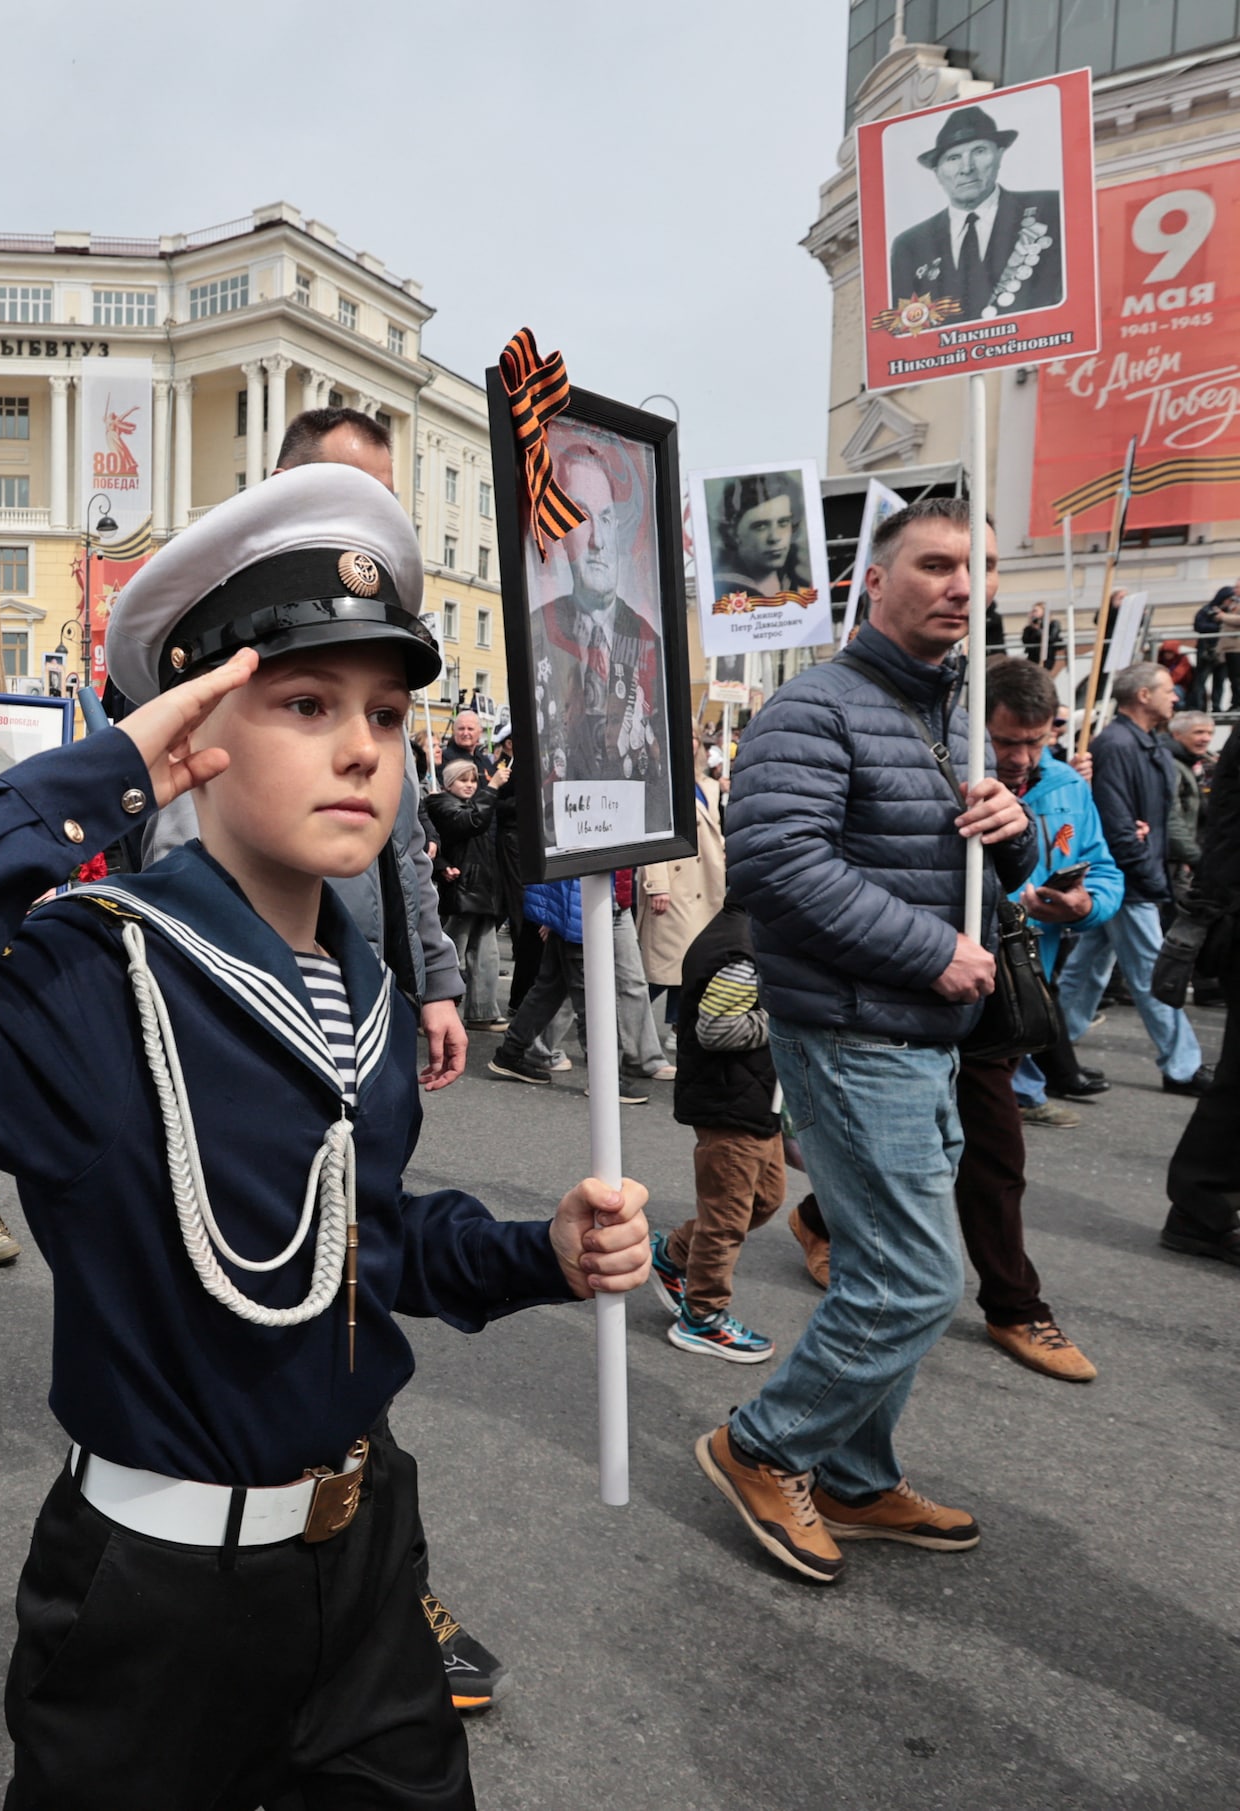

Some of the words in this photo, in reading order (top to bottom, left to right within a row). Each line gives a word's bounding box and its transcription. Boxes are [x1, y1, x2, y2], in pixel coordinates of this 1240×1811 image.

[1132, 189, 1216, 284] 9
[1121, 282, 1215, 317] мая
[939, 322, 1017, 347] Макиша
[889, 349, 966, 375] Николай
[971, 332, 1073, 359] Семёнович
[1124, 365, 1240, 449] Побед
[93, 452, 121, 475] 80
[92, 476, 139, 491] ПОБЕДА!
